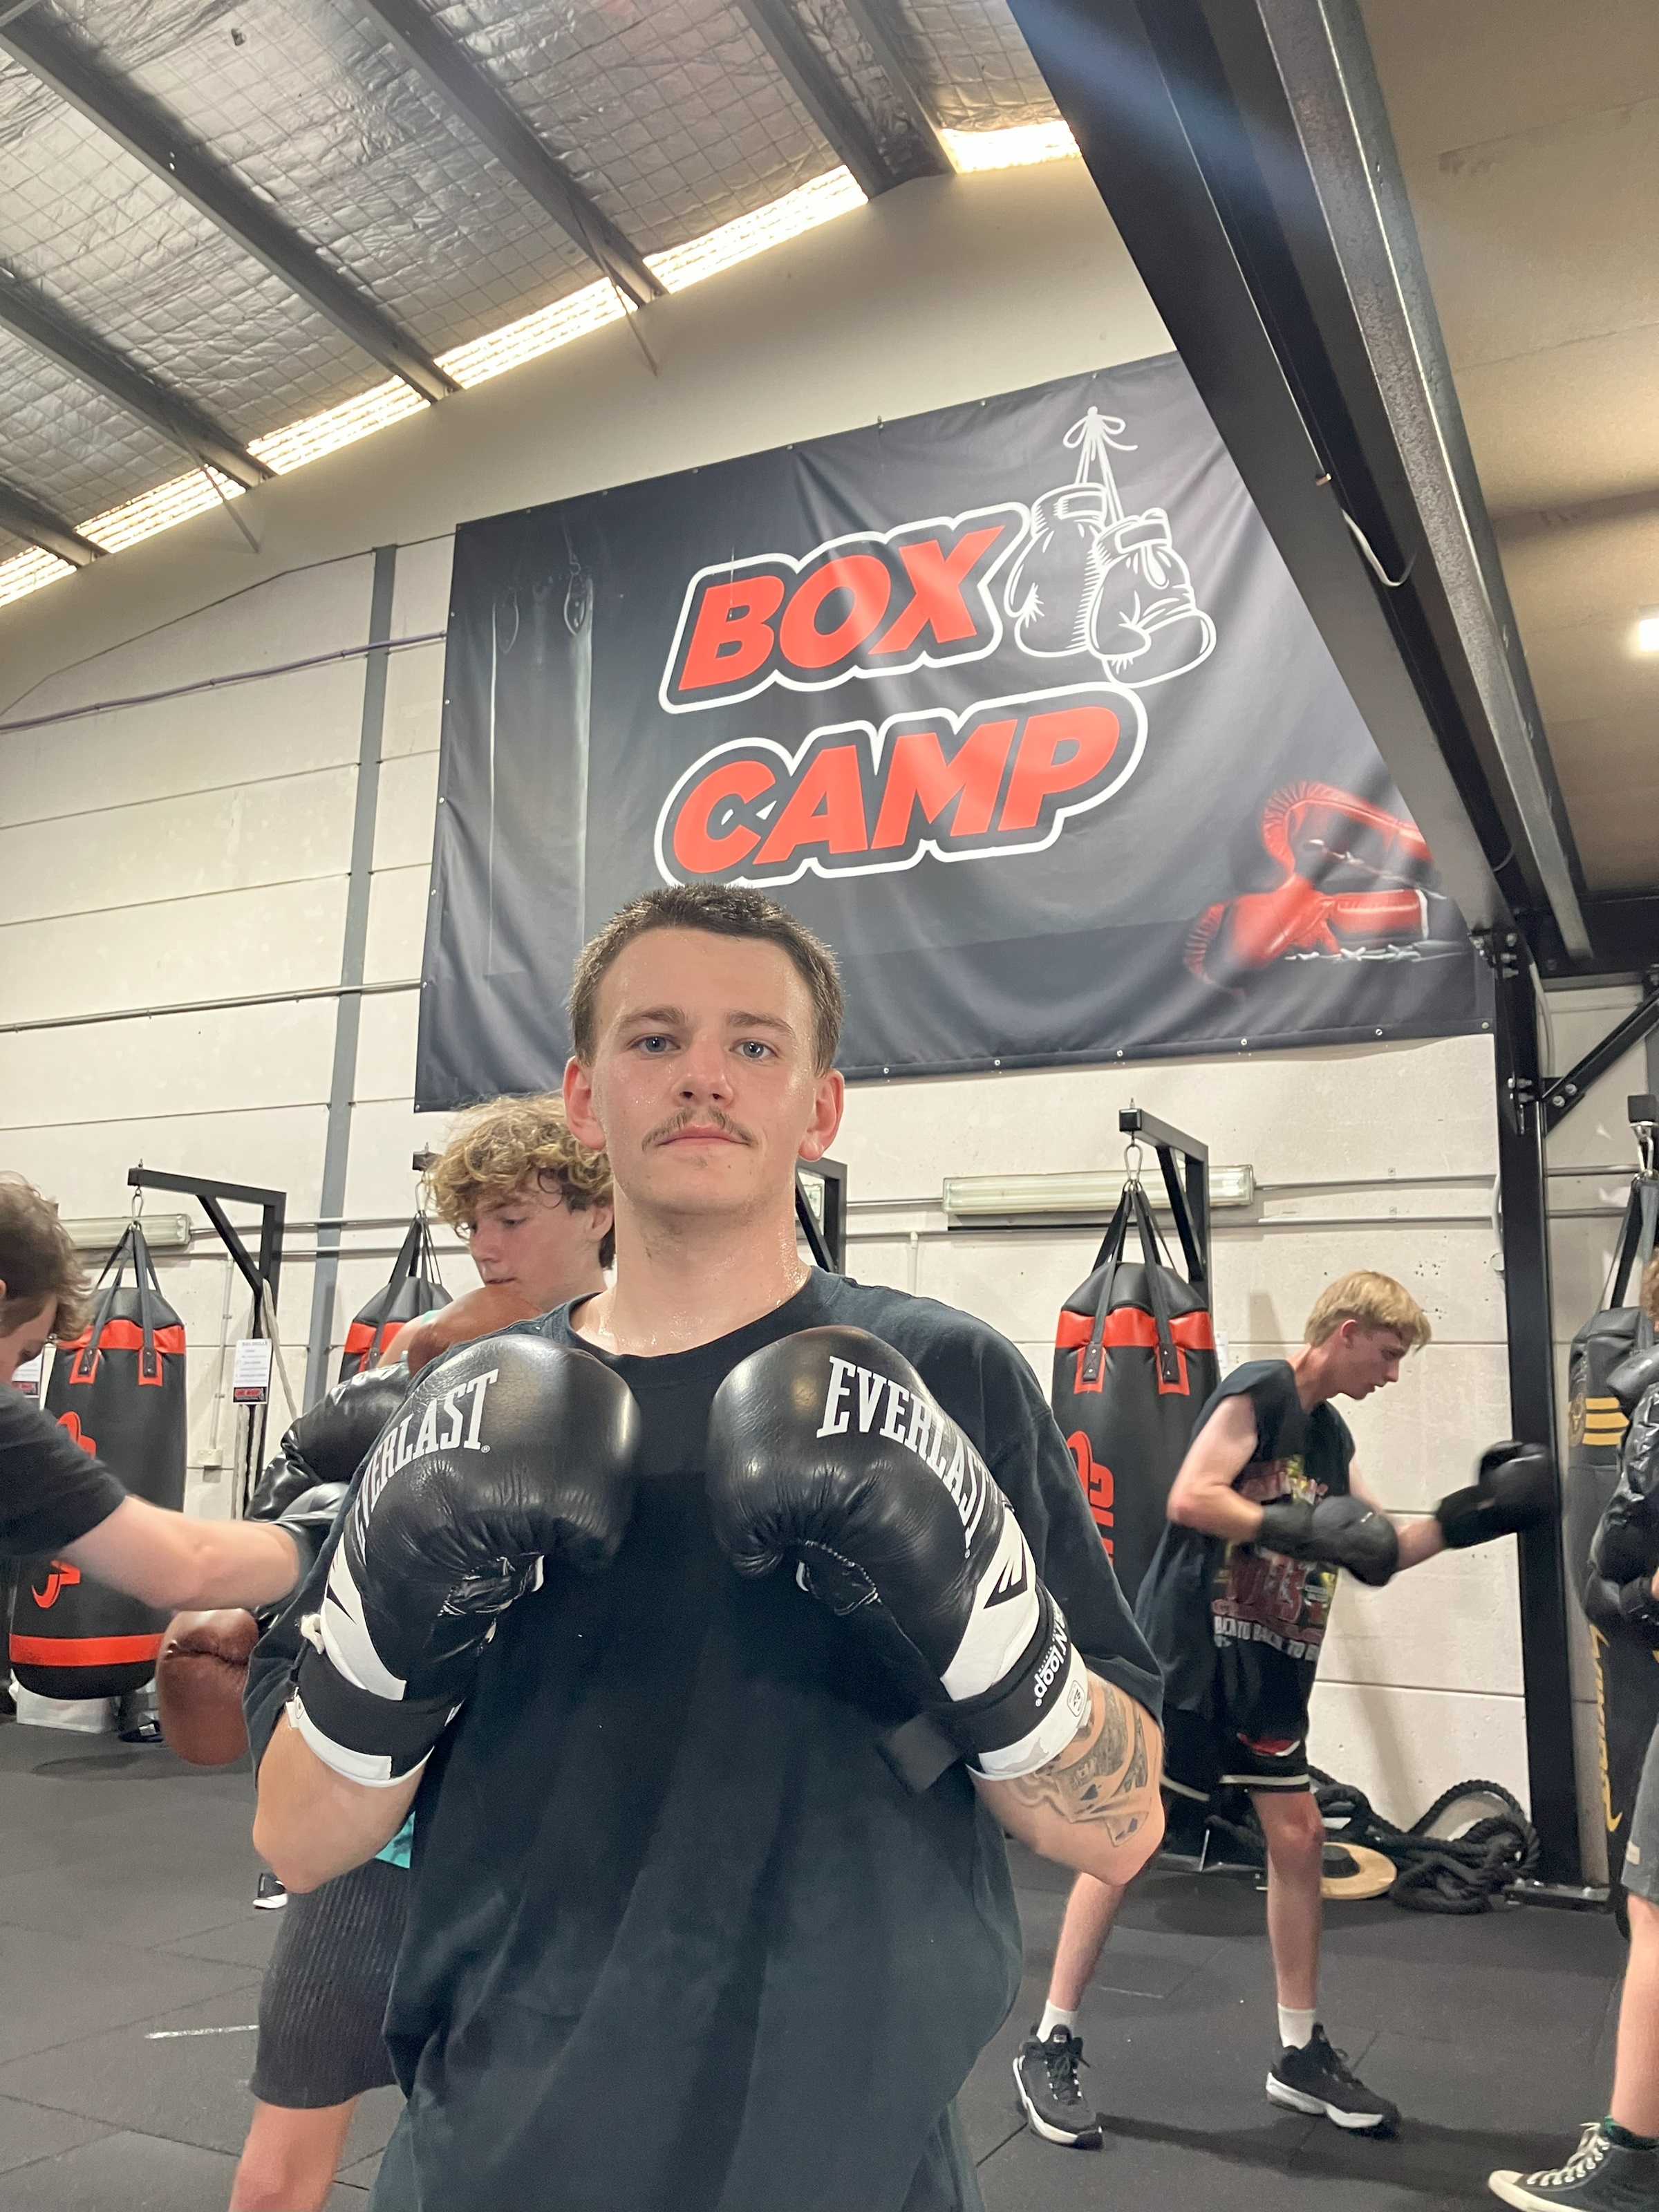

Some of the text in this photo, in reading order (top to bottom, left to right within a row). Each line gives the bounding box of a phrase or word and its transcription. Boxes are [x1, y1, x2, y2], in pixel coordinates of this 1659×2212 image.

[679, 526, 1005, 690] BOX
[673, 706, 1120, 873] CAMP
[816, 1356, 990, 1549] EVERLAST
